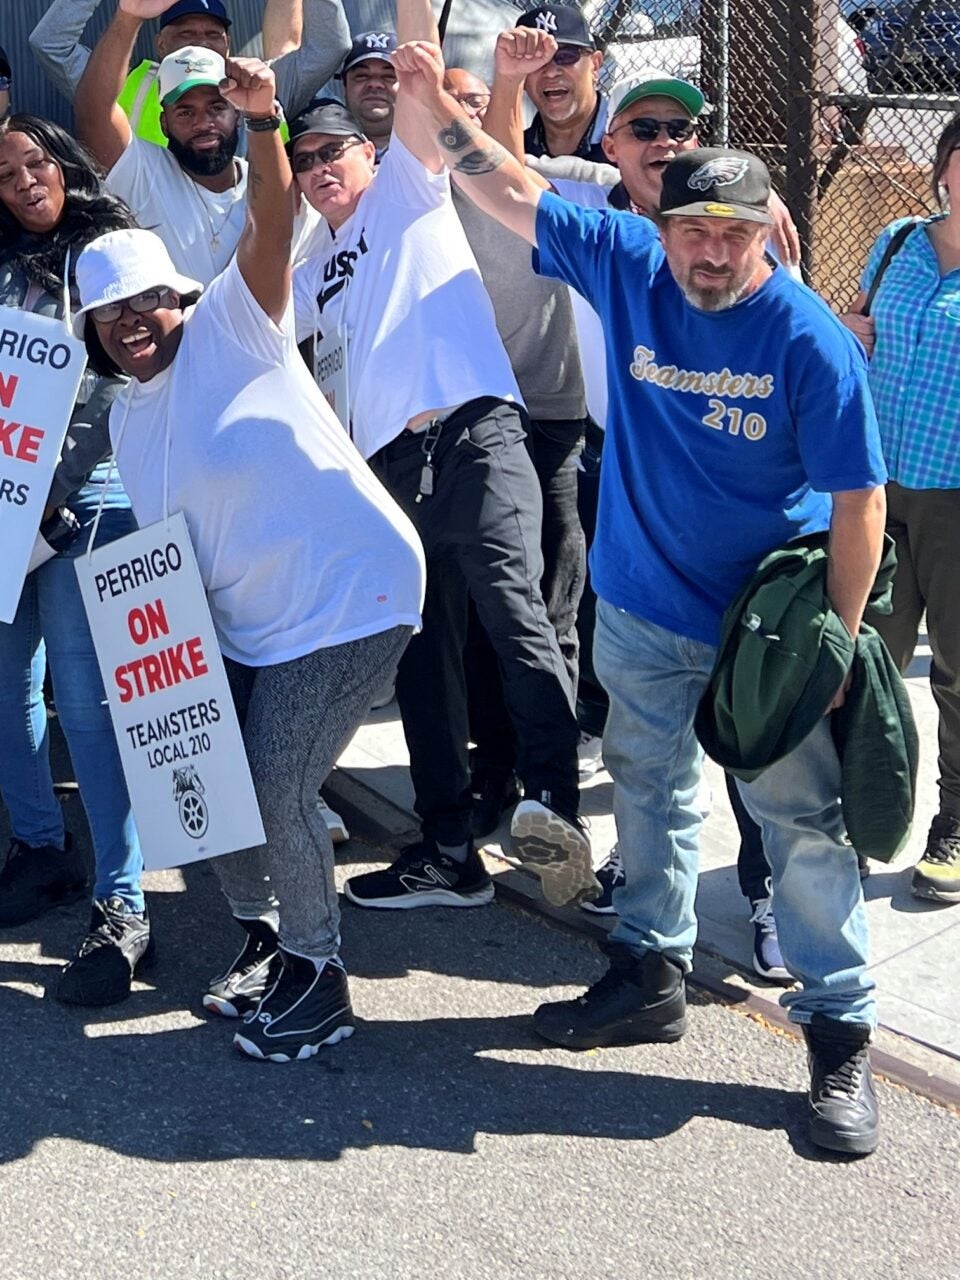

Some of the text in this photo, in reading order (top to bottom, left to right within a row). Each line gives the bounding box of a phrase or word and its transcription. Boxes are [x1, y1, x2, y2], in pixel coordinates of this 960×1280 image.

[629, 345, 774, 399] Teamsters
[702, 399, 767, 441] 210
[94, 542, 182, 603] PERRIGO
[127, 598, 170, 646] ON
[114, 636, 209, 703] STRIKE
[125, 698, 221, 750] TEAMSTERS
[147, 732, 211, 769] LOCAL 210
